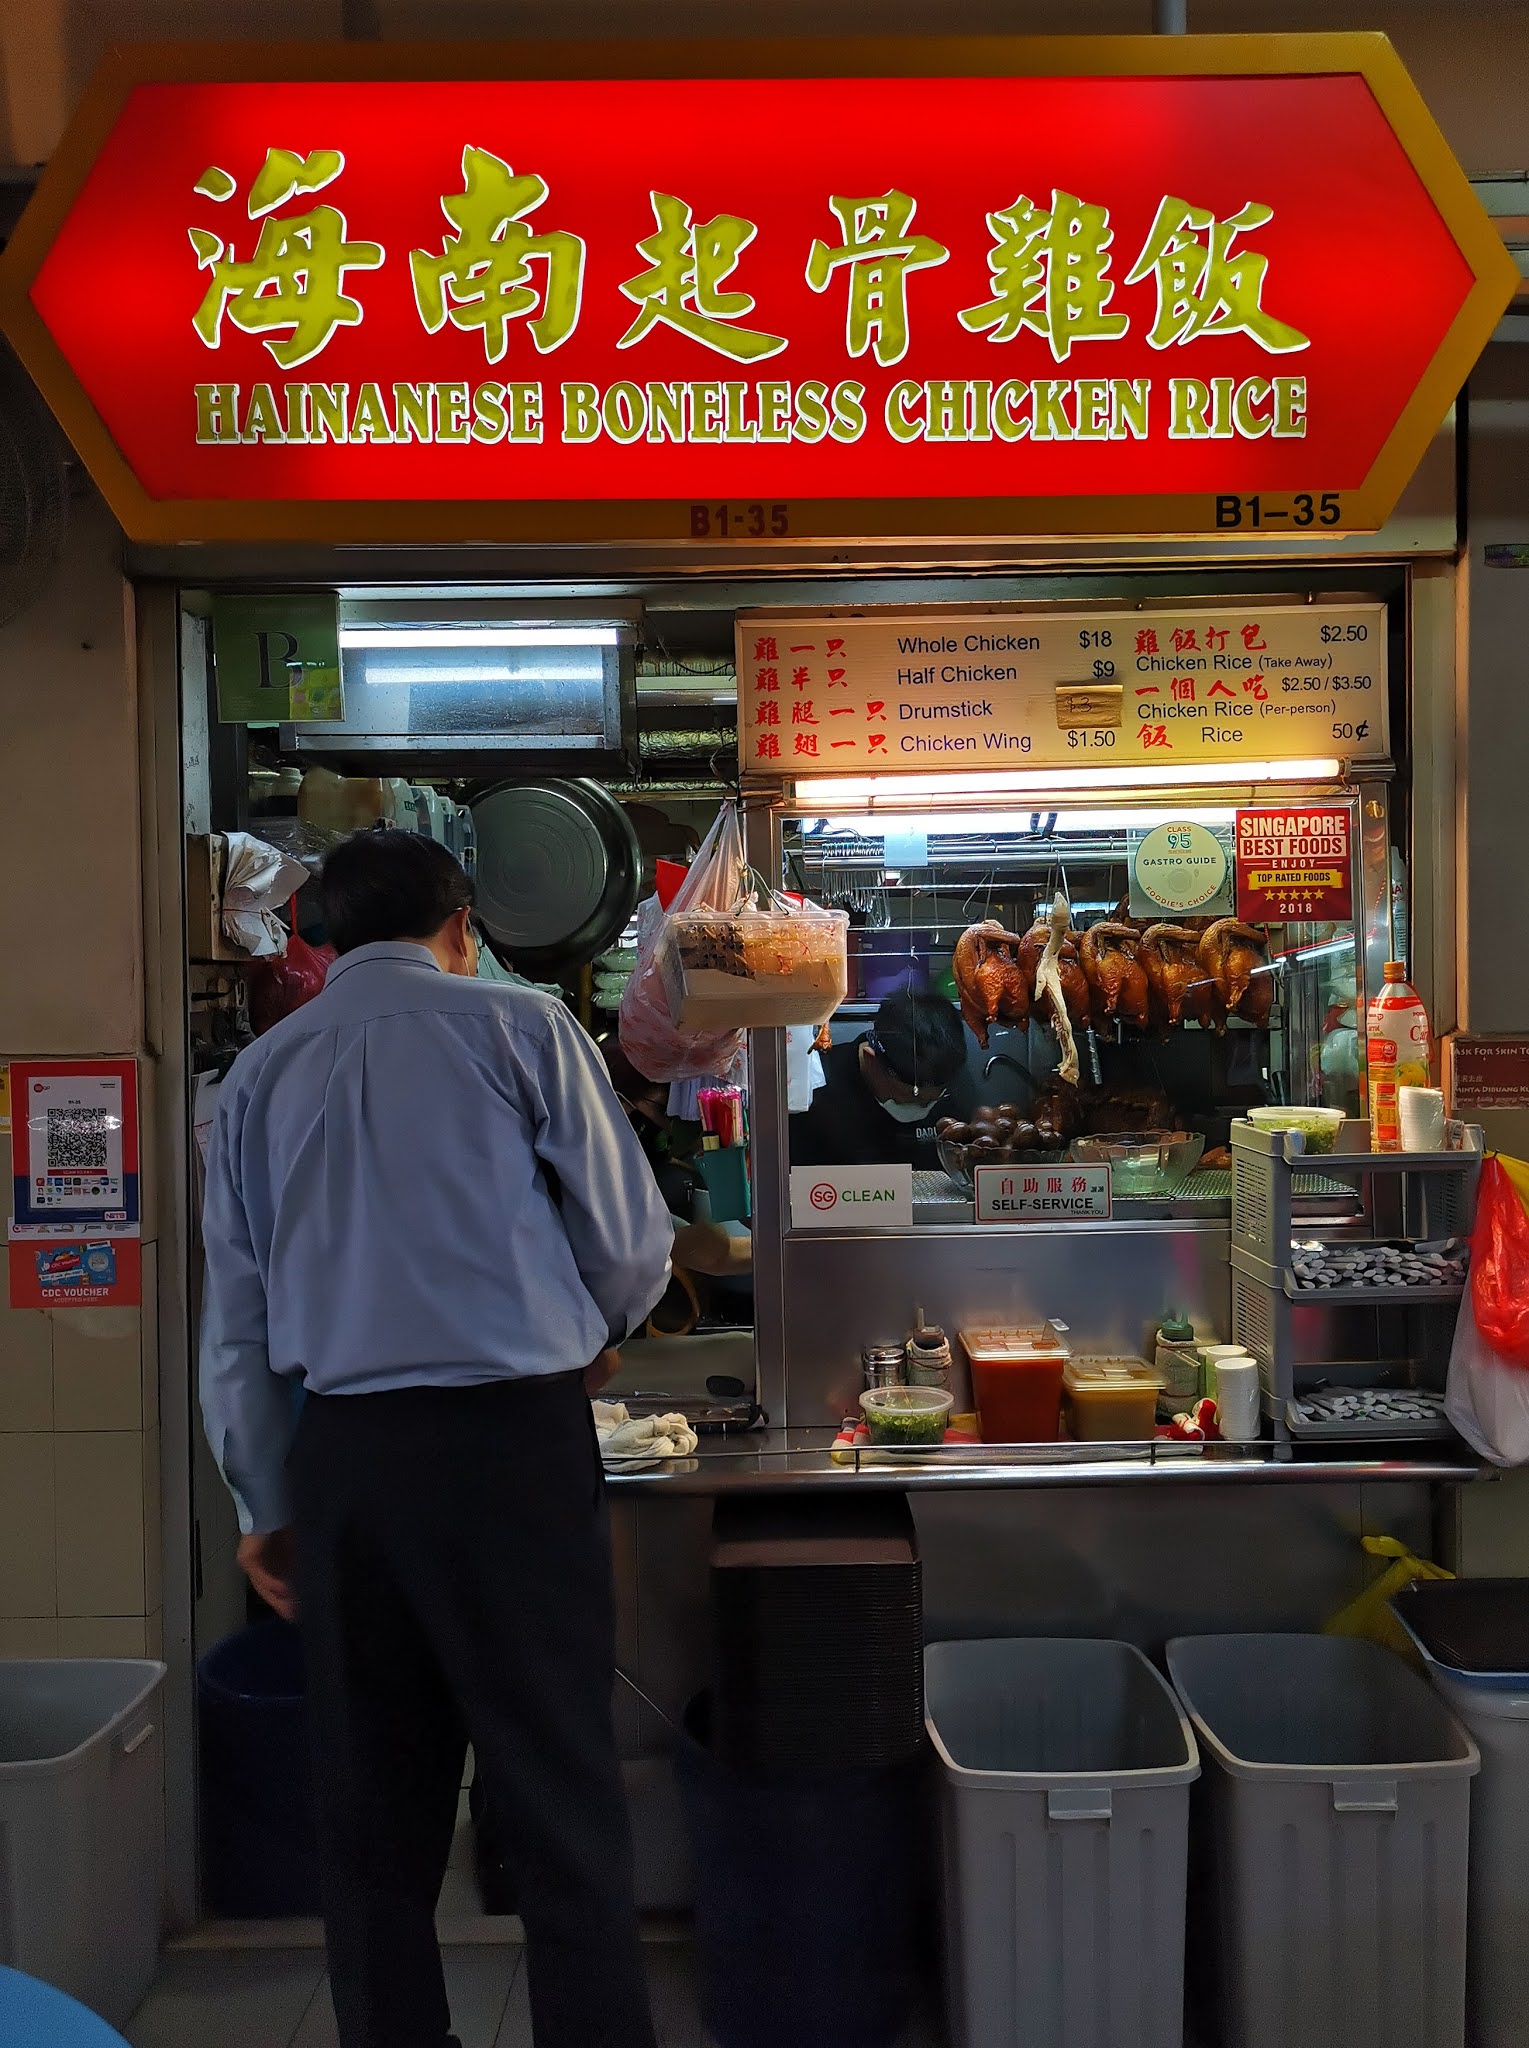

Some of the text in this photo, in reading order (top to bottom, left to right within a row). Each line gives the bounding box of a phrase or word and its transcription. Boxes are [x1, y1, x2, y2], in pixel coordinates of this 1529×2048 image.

[188, 144, 1311, 369] 海南起骨雞飯
[194, 375, 1308, 445] HAINANESE BONELESS CHICKEN RICE
[1216, 493, 1342, 528] B1-35
[689, 505, 790, 538] B1-35
[897, 629, 1113, 654] Whole Chicken $18
[1133, 623, 1268, 656] 雞飯打包
[1320, 624, 1368, 644] $2.50
[752, 636, 847, 663] 雞一只
[897, 659, 1116, 685] Half Chicken $9
[1136, 652, 1334, 672] Chicken Rice (Take Away)
[753, 665, 849, 693] 雞半只
[1281, 676, 1322, 692] $2.50
[1331, 675, 1372, 691] $3.50
[899, 700, 993, 720] Drumstick
[1137, 699, 1337, 719] Chicken Rice (Per-person)
[900, 729, 1116, 753] Chicken Wing $1.50
[1135, 722, 1174, 750] 飯
[1201, 726, 1244, 744] Rice
[1240, 815, 1346, 837] SINGAPORE
[1167, 832, 1192, 849] 95
[1243, 837, 1342, 856] BEST FOODS
[1142, 856, 1217, 866] GASTRO GUIDE
[1272, 859, 1315, 868] ENJOY
[1257, 872, 1331, 882] TOP RATED FOODS
[1145, 884, 1217, 908] FOODIE'S CHOICE
[1279, 902, 1313, 914] 2018
[1474, 1047, 1494, 1056] FOR
[1495, 1047, 1518, 1055] SKIN
[1001, 1176, 1087, 1195] 自助服務
[813, 1189, 895, 1204] SG CLEAN
[991, 1197, 1094, 1211] SELF-SERVICE
[41, 1287, 109, 1298] CDC VOUCHER
